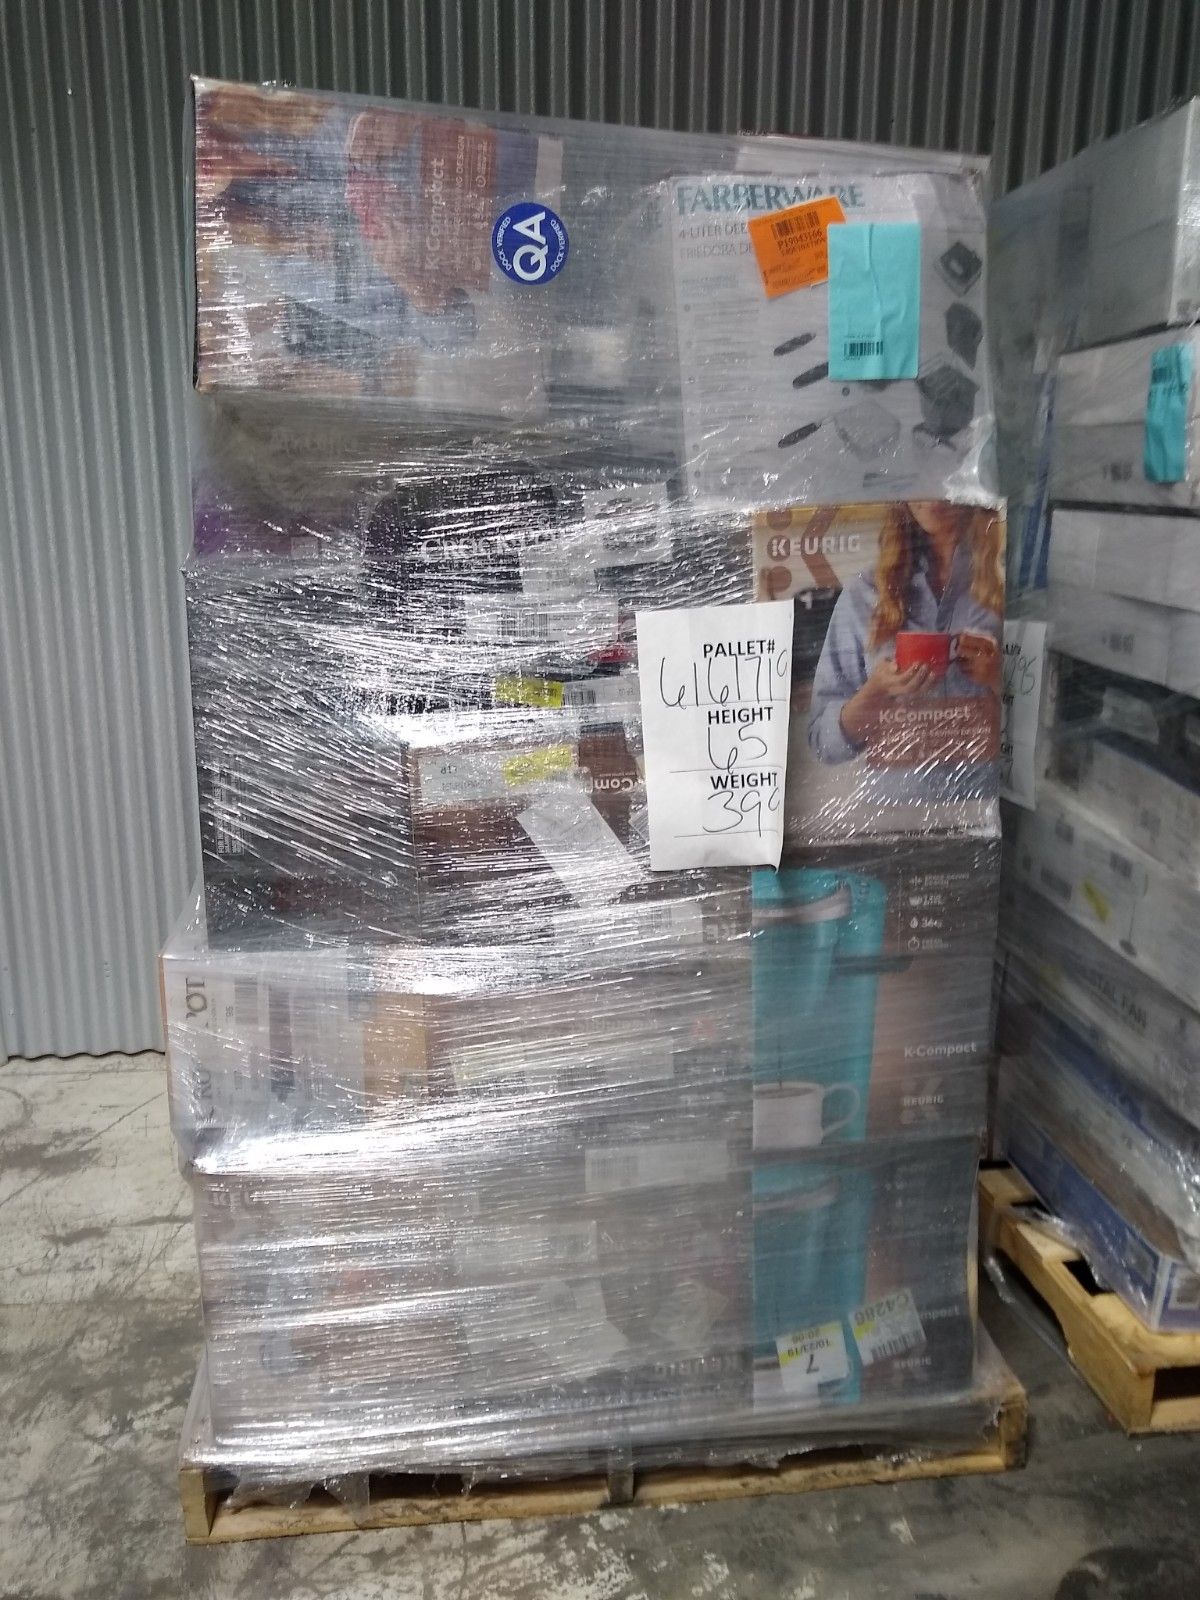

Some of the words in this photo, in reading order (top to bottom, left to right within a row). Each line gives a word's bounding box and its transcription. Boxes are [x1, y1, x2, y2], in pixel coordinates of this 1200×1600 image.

[496, 216, 512, 248] VERIFIED
[550, 220, 566, 252] VERIFIED
[512, 211, 549, 281] QA
[497, 248, 512, 271] DOCK
[550, 252, 564, 272] DOCK
[771, 535, 862, 556] KEURIG
[703, 639, 775, 658] PALLET#
[708, 707, 773, 725] HEIGHT
[710, 772, 777, 790] WEIGHT
[806, 1353, 820, 1374] 7
